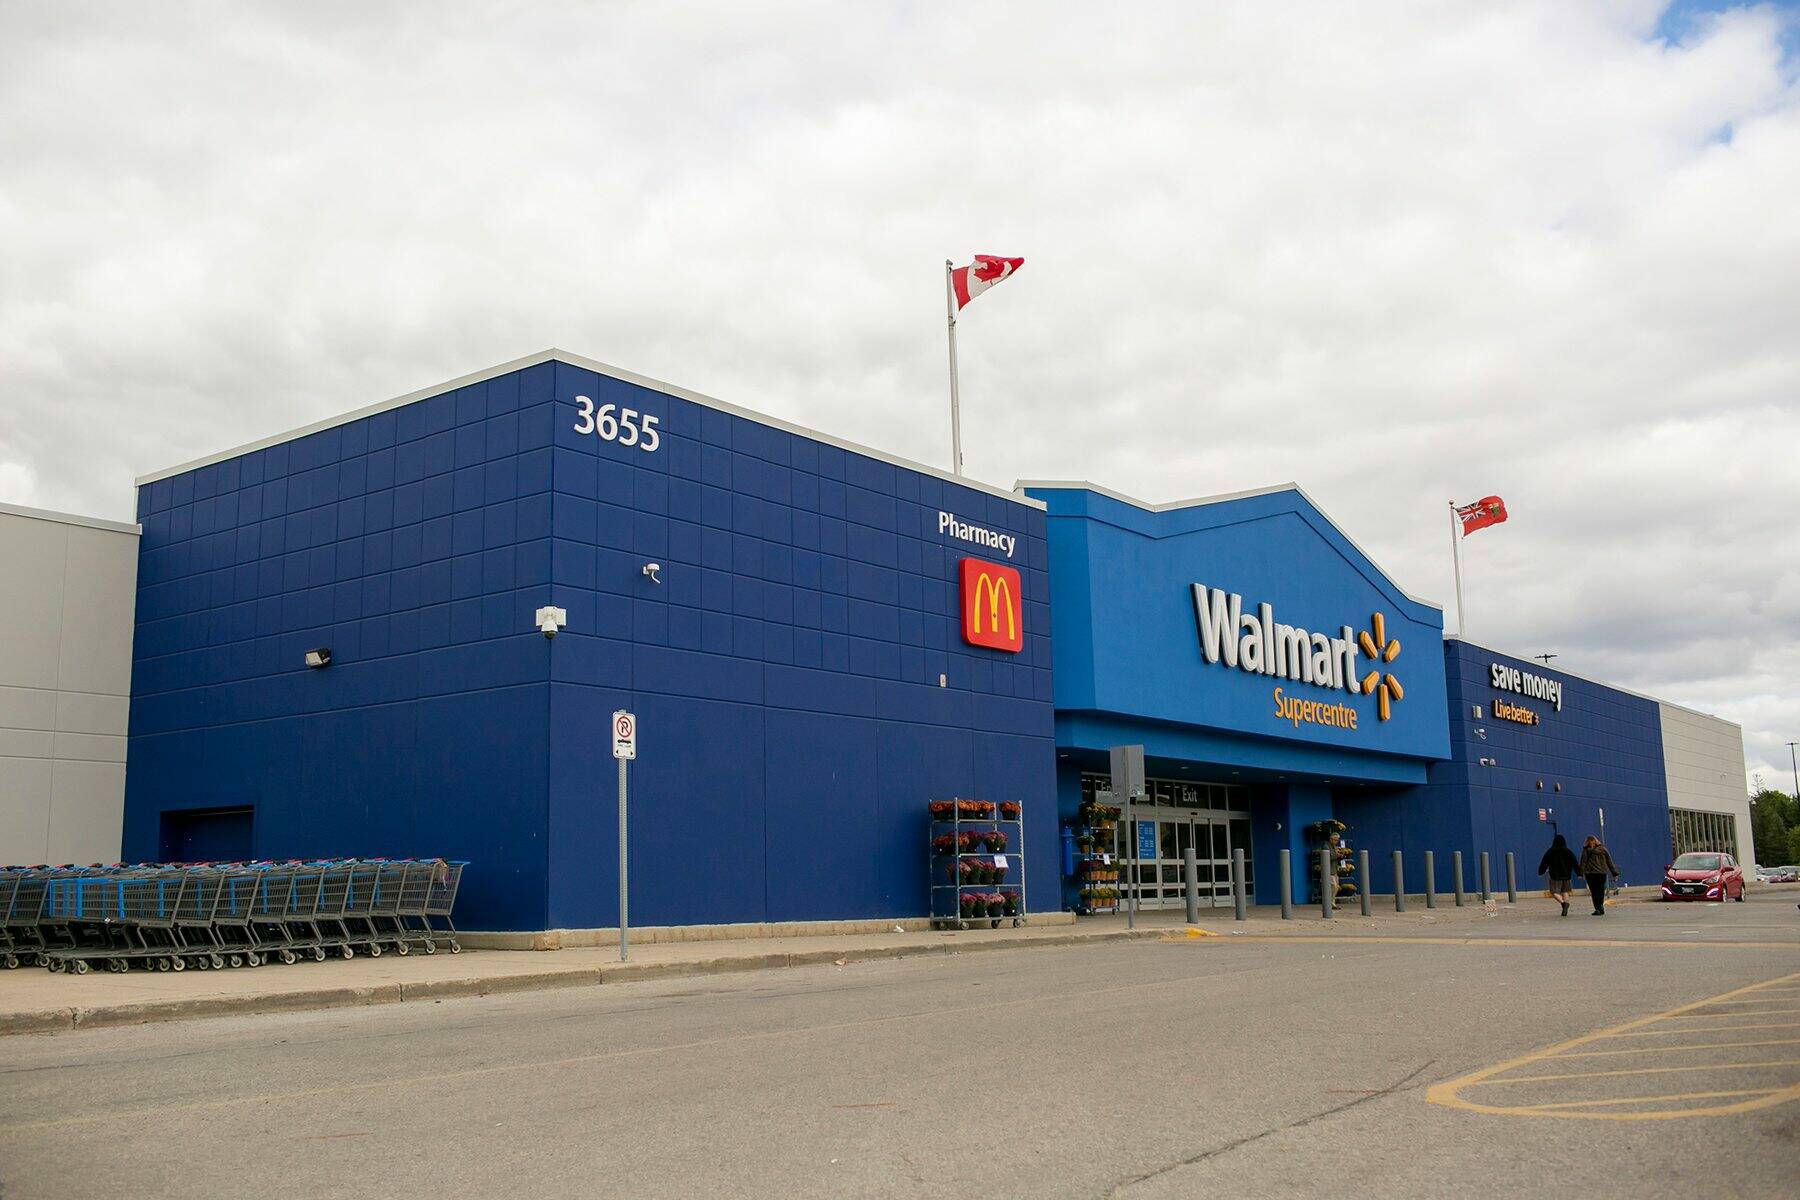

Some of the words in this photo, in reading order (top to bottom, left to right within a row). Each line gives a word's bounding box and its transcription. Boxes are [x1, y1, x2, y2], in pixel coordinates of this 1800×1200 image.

[573, 395, 660, 452] 3655
[938, 511, 1016, 558] Pharmacy
[1192, 582, 1361, 694] Walmart
[1273, 687, 1358, 729] Supercentre
[1491, 662, 1522, 693] save
[1522, 671, 1562, 712] money
[1494, 699, 1511, 720] Live
[1511, 702, 1535, 725] better
[1182, 787, 1198, 803] Exit
